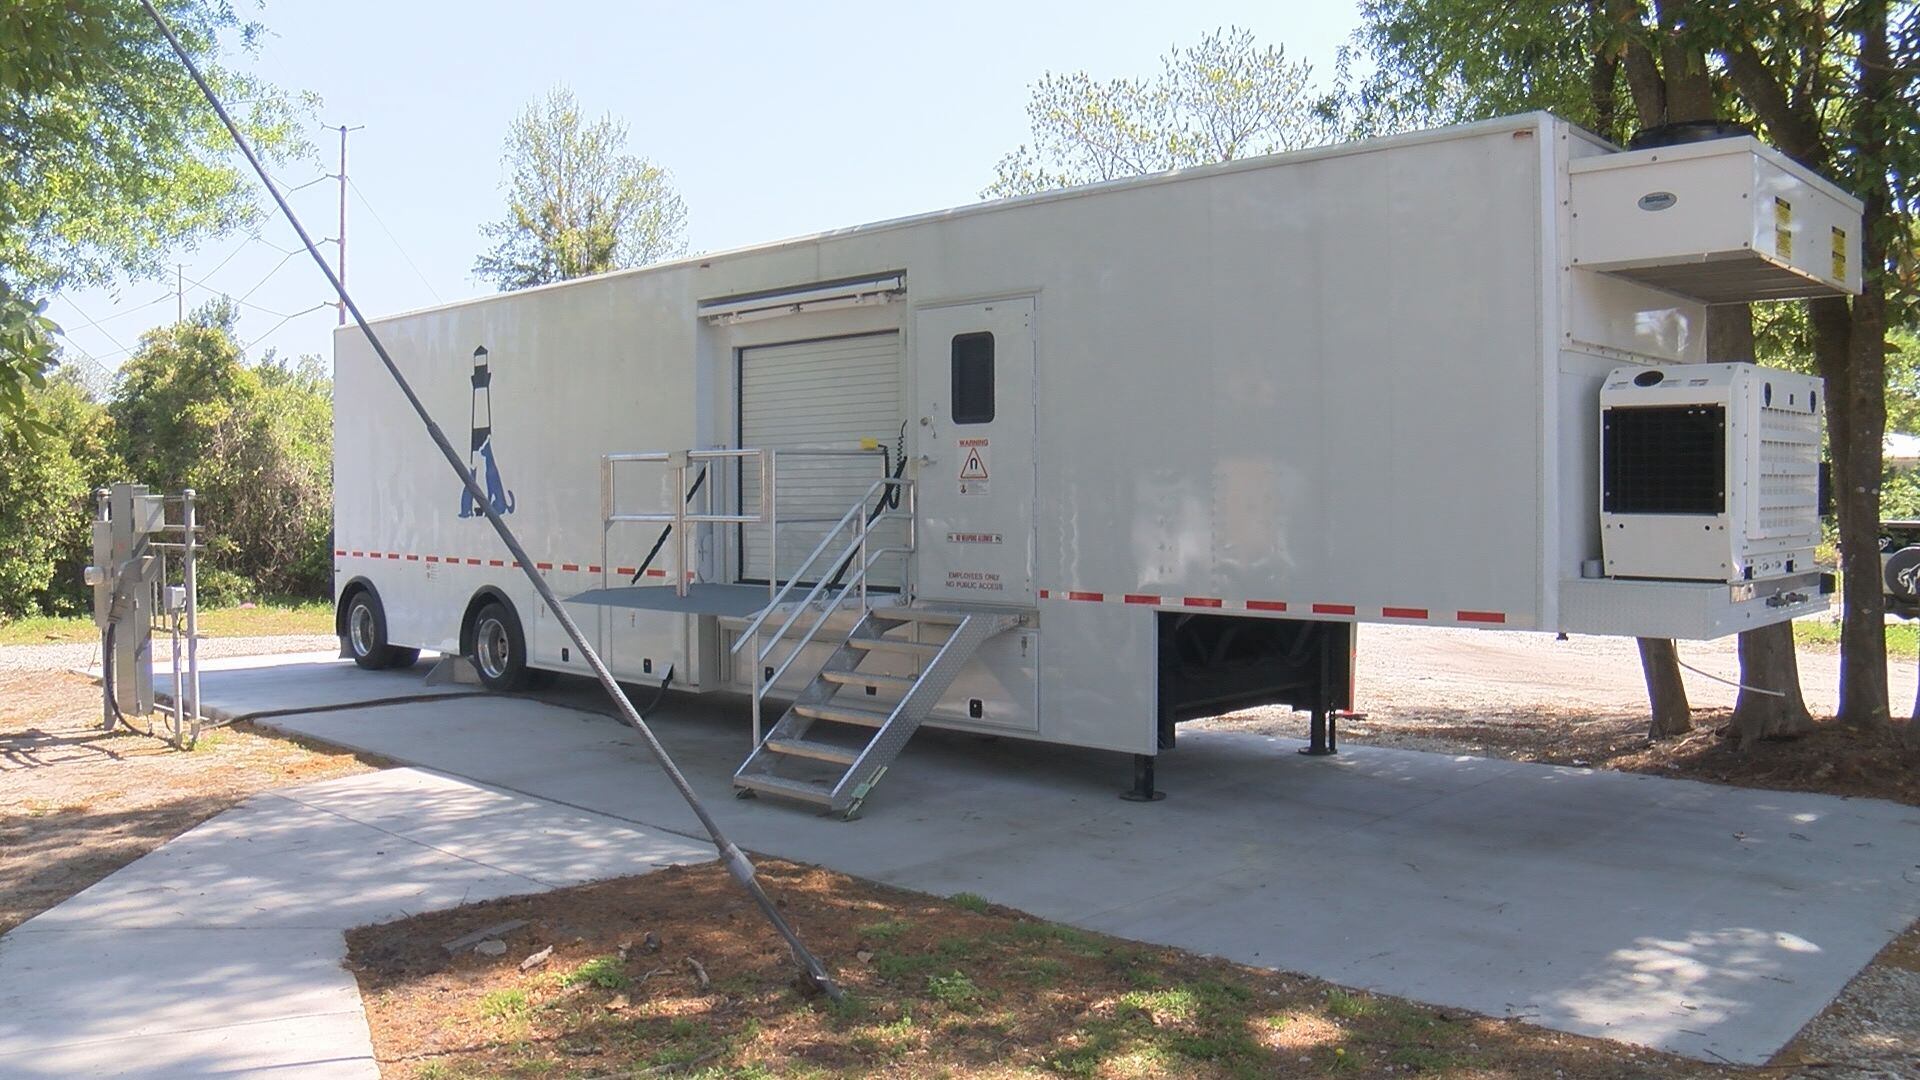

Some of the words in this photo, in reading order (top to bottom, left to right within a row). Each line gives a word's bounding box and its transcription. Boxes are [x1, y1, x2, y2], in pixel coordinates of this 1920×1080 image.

[959, 439, 988, 448] WARNING
[948, 572, 983, 581] EMPLOYEES
[984, 573, 1001, 582] ONLY
[956, 581, 977, 589] PUBLIC
[978, 582, 1003, 591] ACCESS
